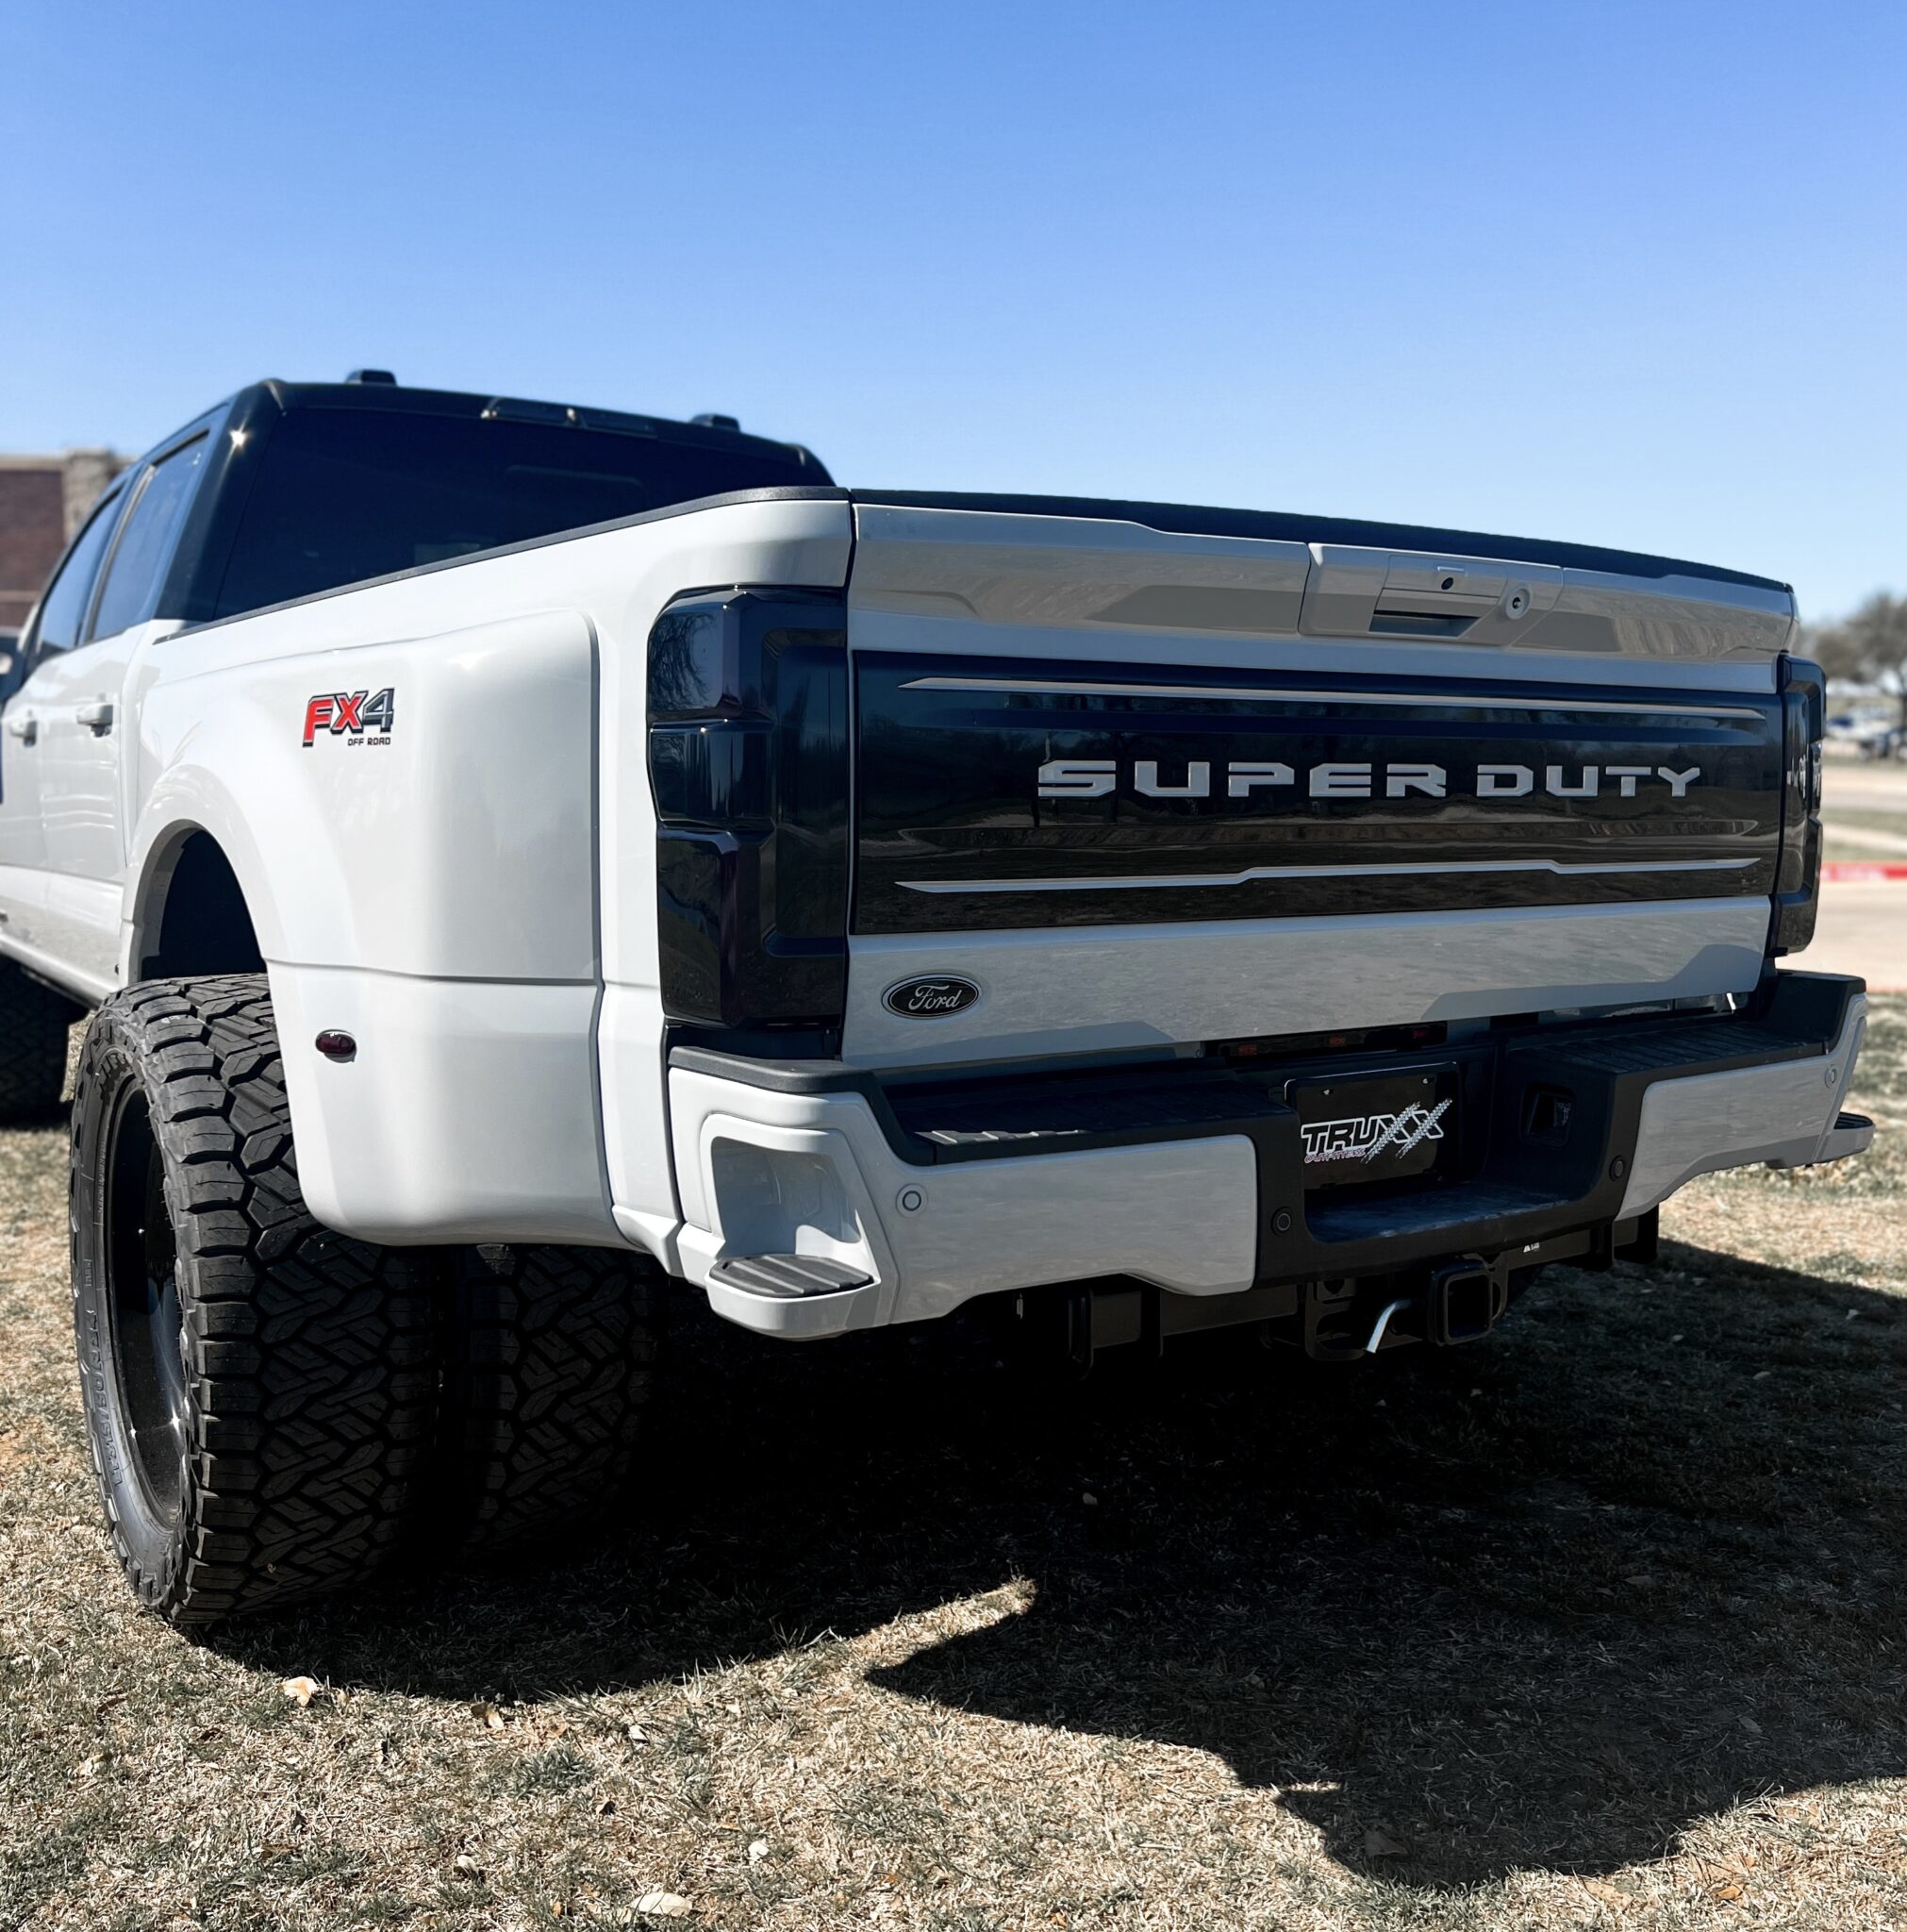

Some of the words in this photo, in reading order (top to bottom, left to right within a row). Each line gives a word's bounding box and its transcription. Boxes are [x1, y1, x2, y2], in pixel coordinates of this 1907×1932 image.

[302, 687, 395, 748] FX4
[347, 738, 364, 746] OFF
[367, 737, 391, 745] ROAD
[1037, 759, 1447, 798] SUPER
[1476, 764, 1701, 798] DUTY
[907, 985, 963, 1010] Ford
[1301, 1098, 1453, 1164] TRUXX
